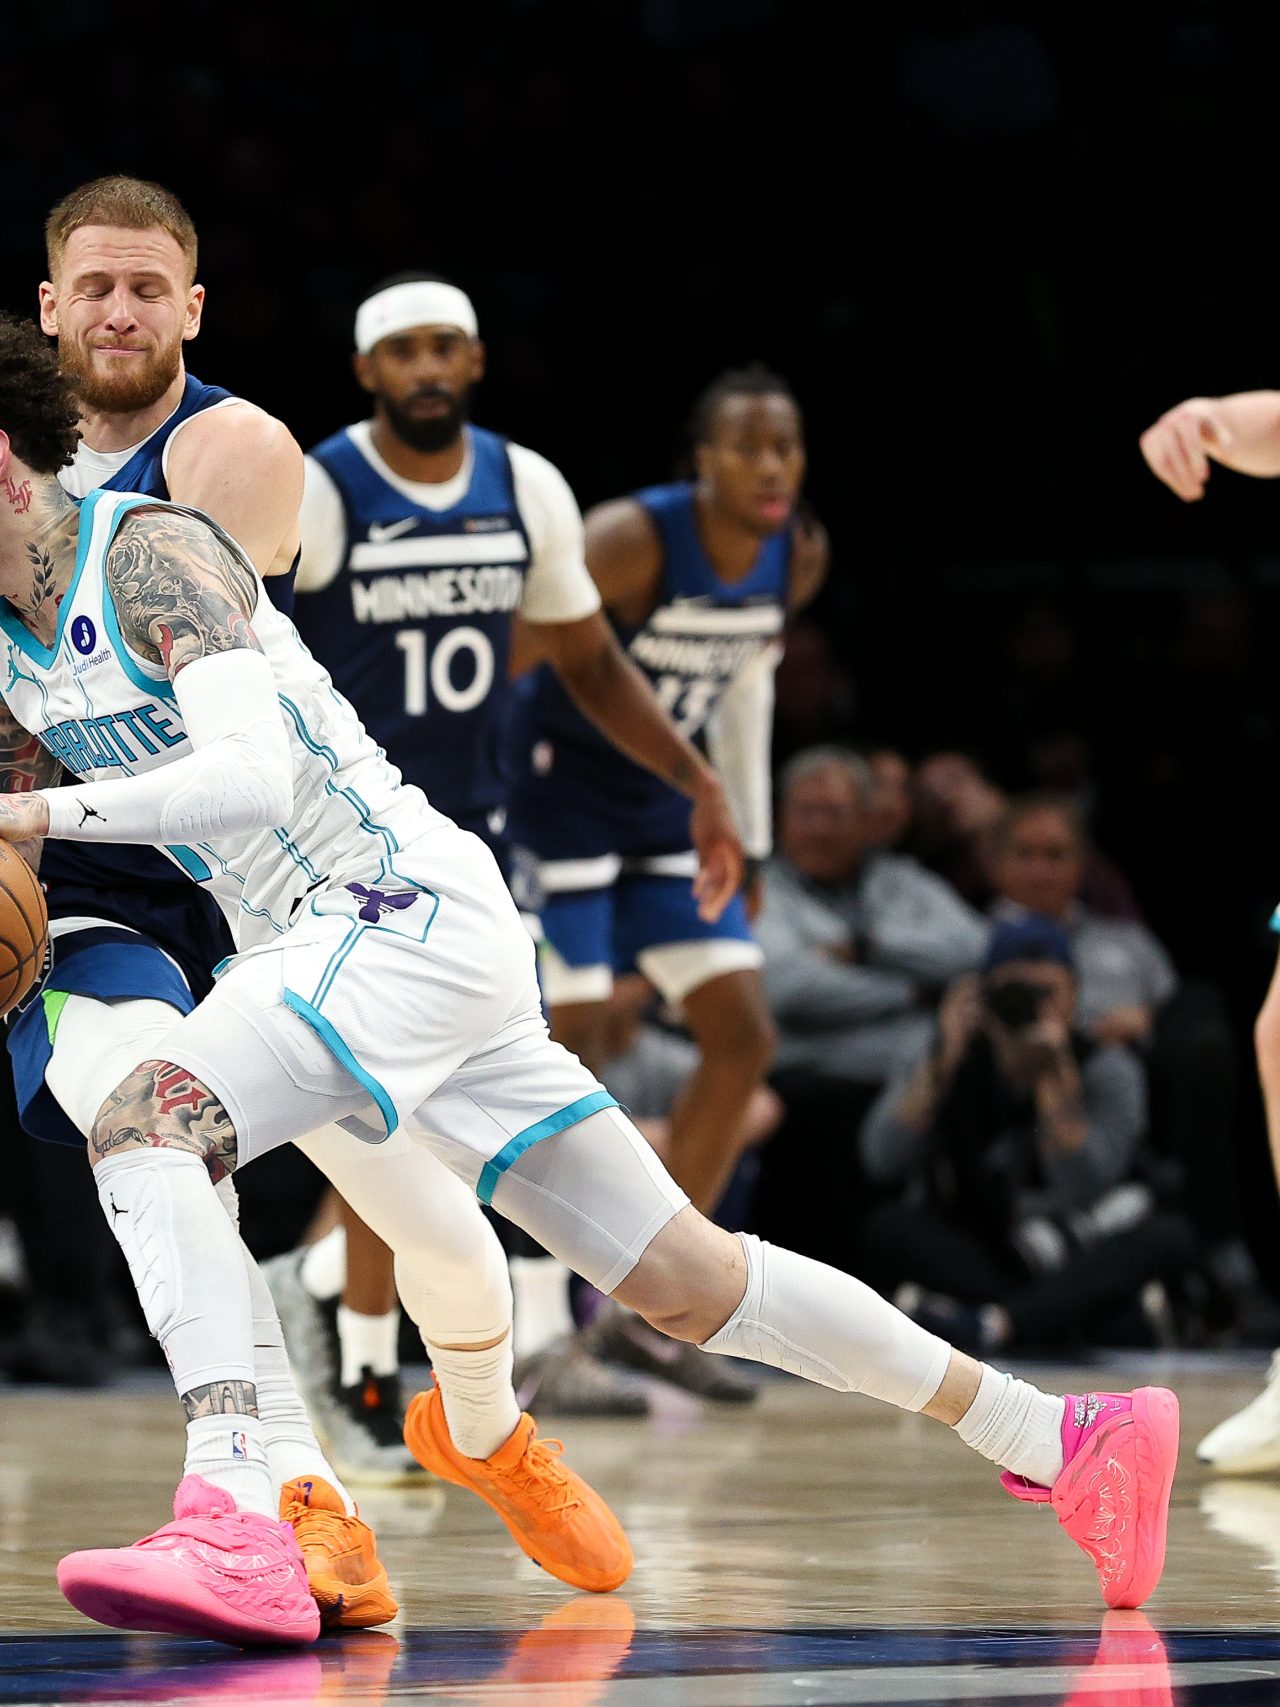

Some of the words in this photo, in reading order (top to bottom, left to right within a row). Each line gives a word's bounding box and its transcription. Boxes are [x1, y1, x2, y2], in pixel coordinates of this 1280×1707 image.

[73, 658, 90, 676] Judi
[88, 648, 112, 668] Health
[394, 625, 495, 717] 10
